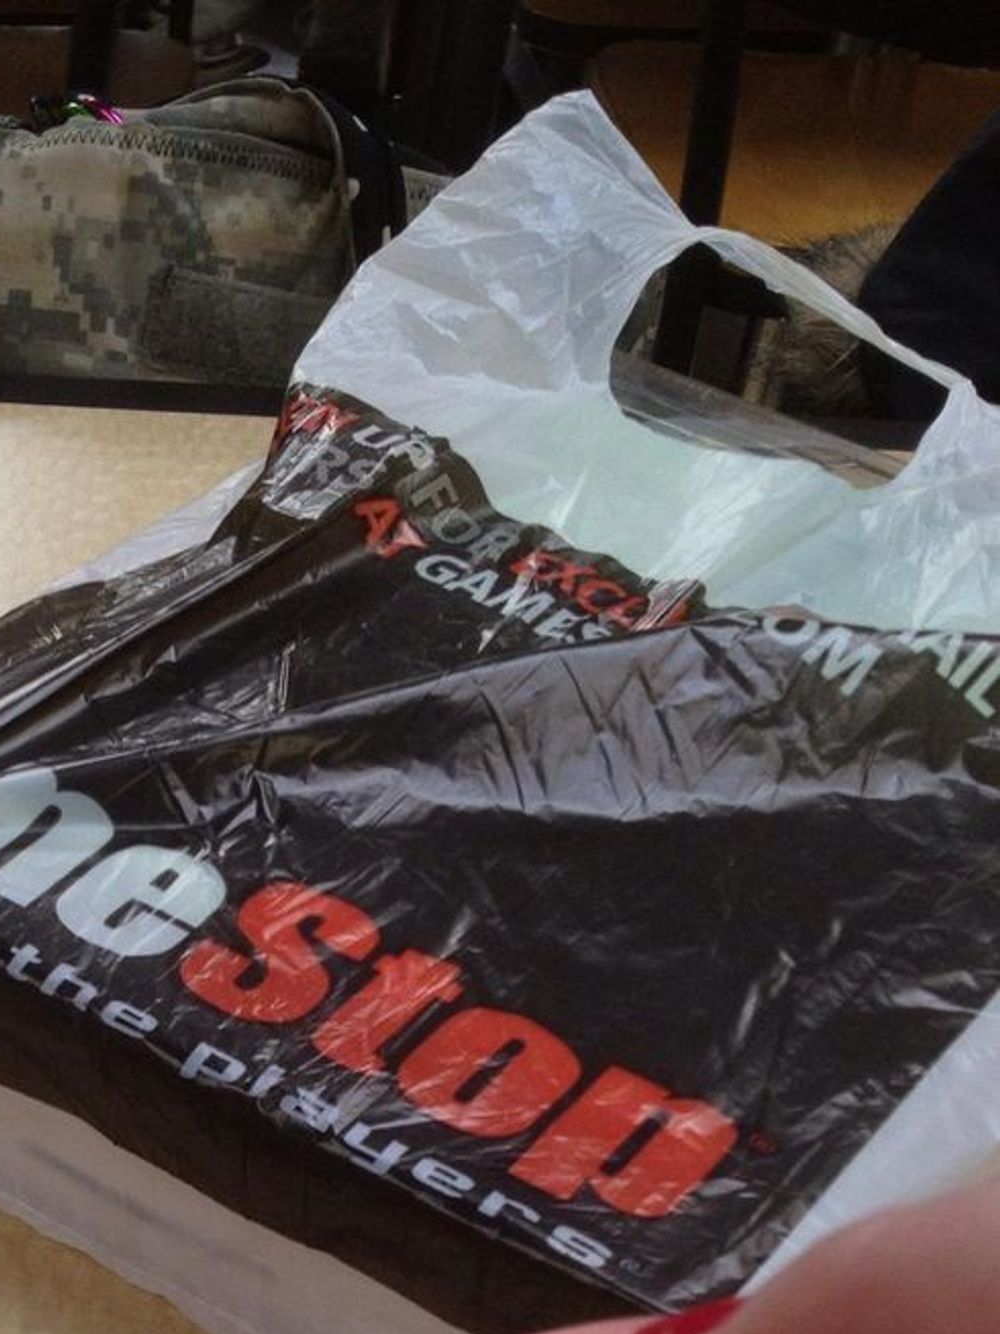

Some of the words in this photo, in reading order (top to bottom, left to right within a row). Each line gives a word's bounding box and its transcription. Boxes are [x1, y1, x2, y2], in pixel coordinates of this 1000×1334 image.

[415, 554, 612, 642] GAMES
[6, 944, 157, 1038] the
[179, 1041, 612, 1268] players
